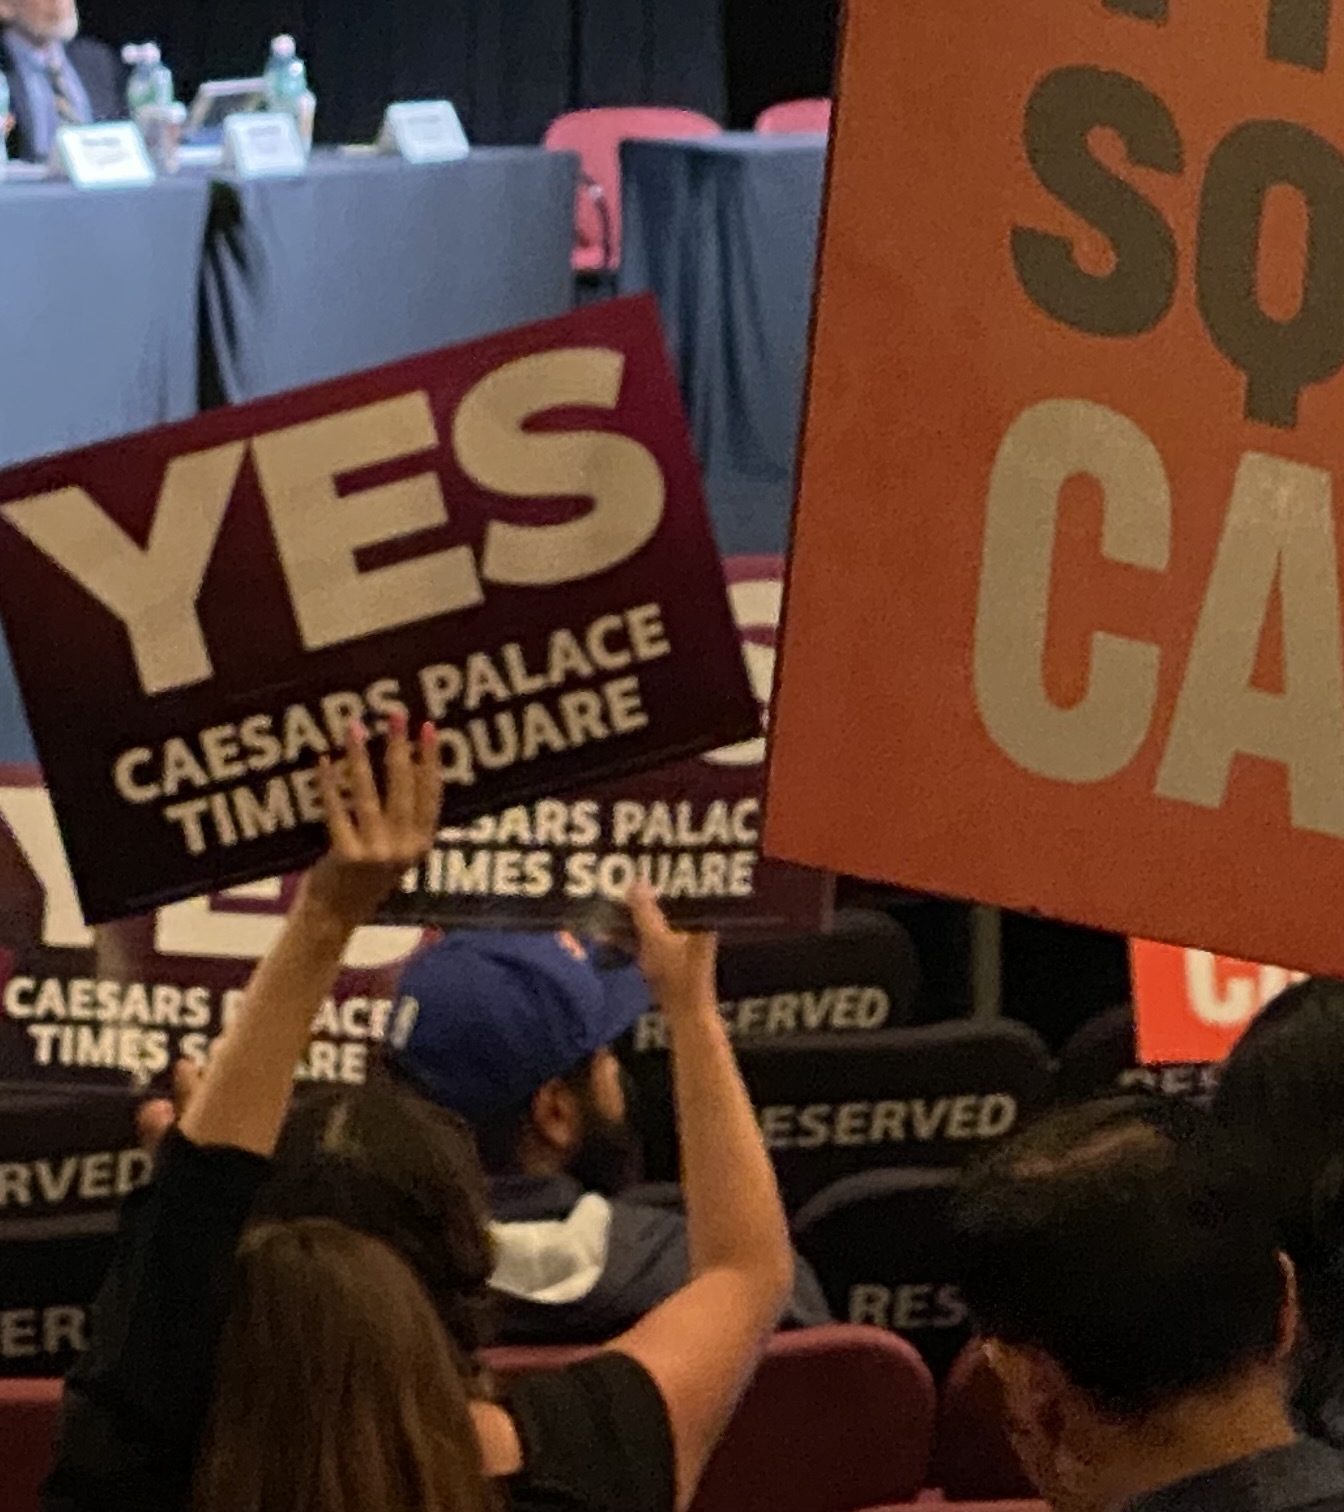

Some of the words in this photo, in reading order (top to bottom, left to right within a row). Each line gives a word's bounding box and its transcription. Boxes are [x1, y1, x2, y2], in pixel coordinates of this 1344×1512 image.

[113, 678, 408, 805] CAESARS
[418, 602, 672, 719] PALACE
[432, 675, 650, 786] QUARE
[613, 797, 759, 846] PALAC
[563, 850, 758, 902] SQUARE
[2, 976, 212, 1029] CAESARS
[26, 1023, 170, 1072] TIMES
[762, 1091, 1019, 1151] ESERVED
